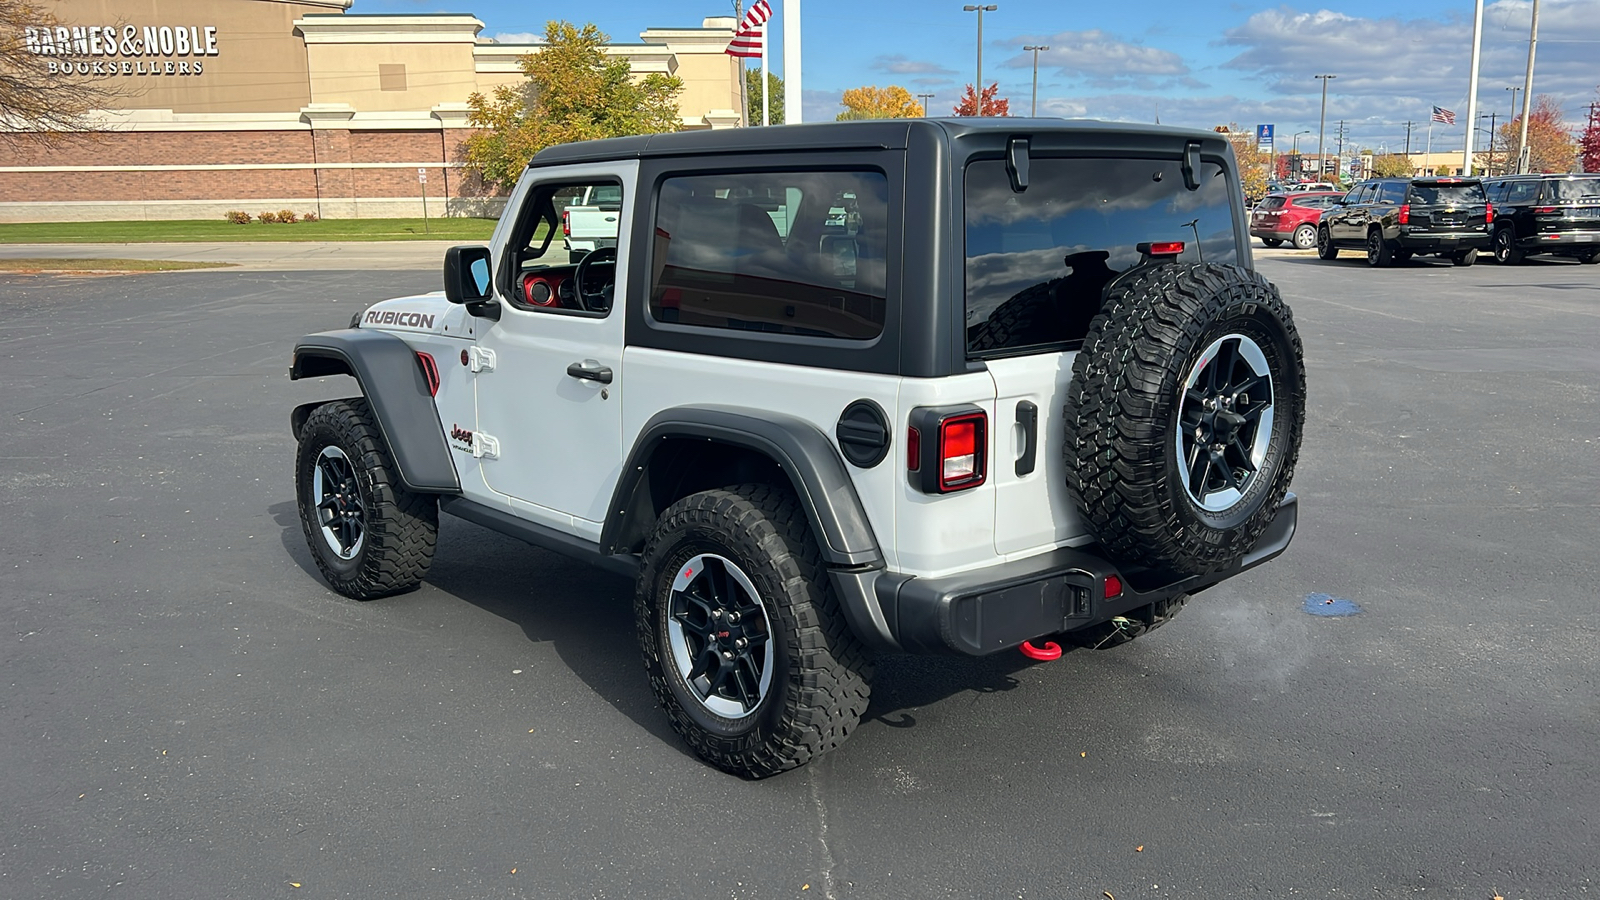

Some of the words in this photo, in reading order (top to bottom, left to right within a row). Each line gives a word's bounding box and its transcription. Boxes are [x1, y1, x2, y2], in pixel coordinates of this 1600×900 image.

[48, 61, 204, 76] BOOKSELLERS
[364, 311, 435, 329] RUBICON
[450, 423, 473, 447] Jeep
